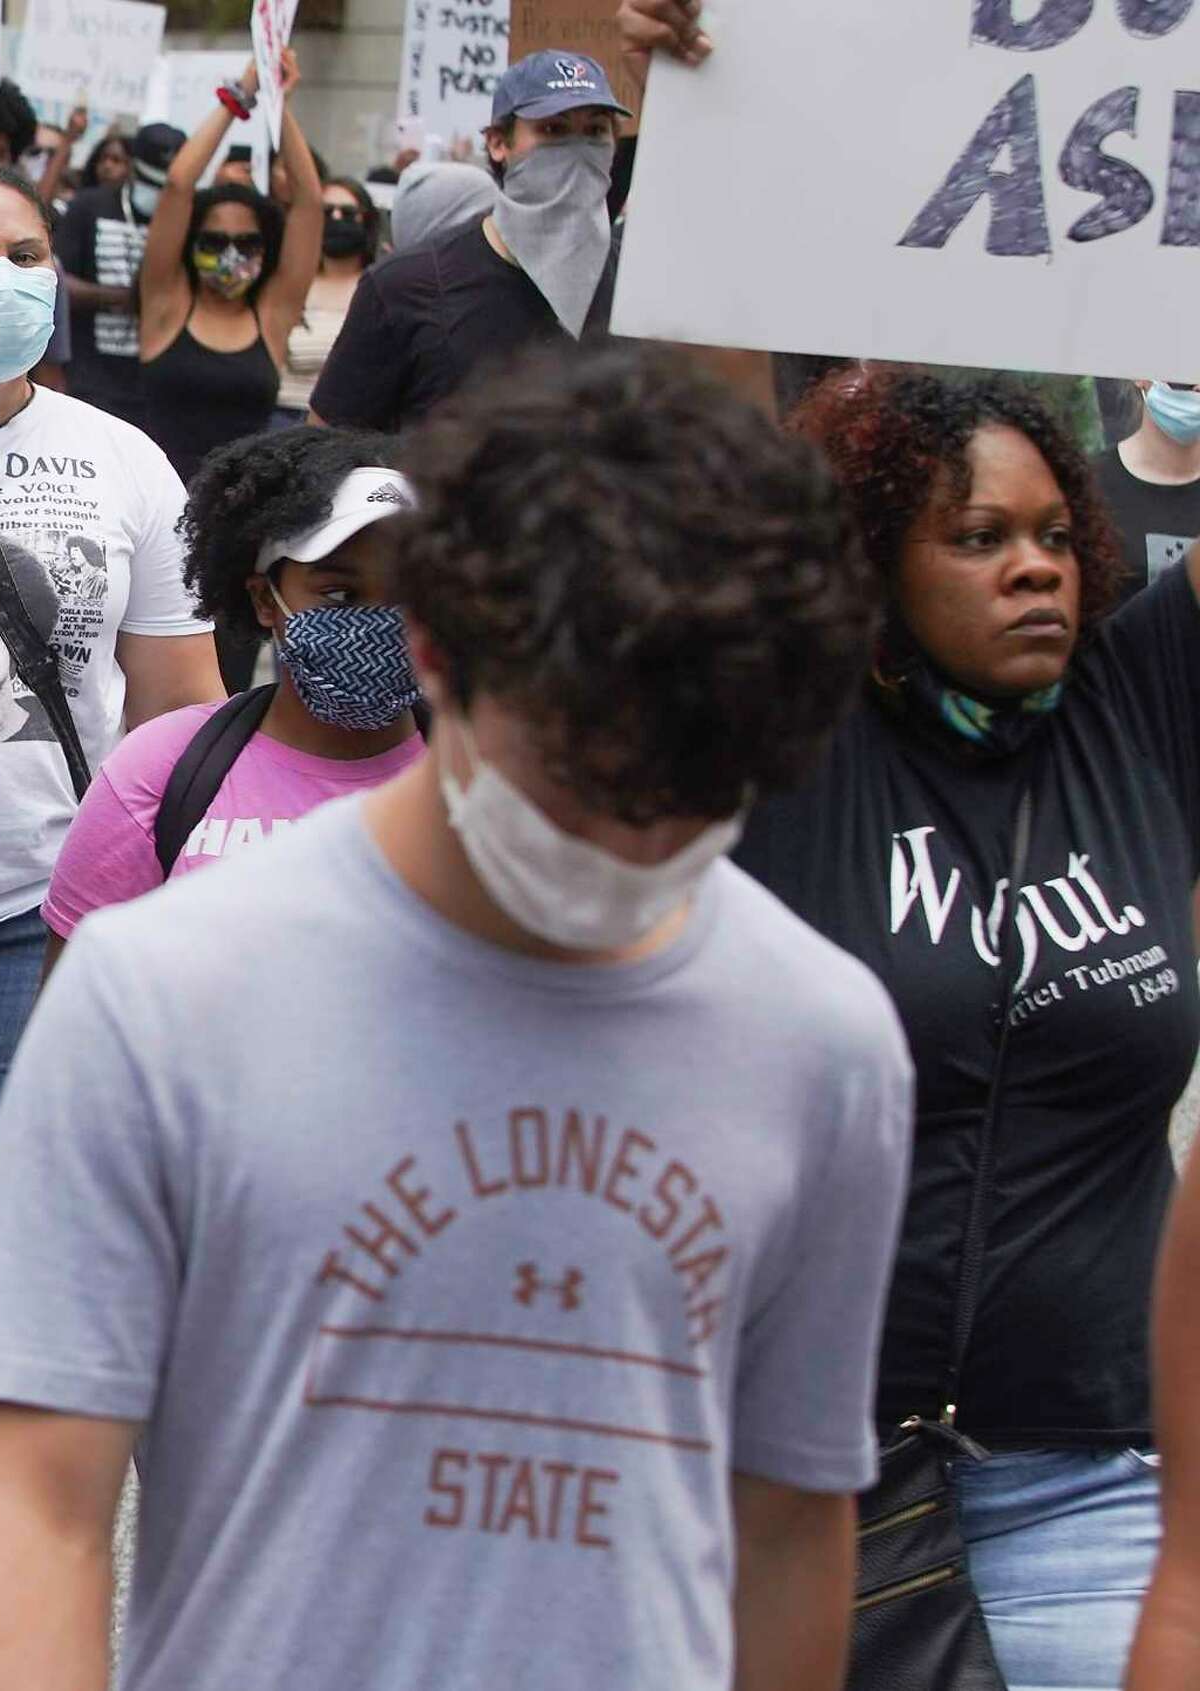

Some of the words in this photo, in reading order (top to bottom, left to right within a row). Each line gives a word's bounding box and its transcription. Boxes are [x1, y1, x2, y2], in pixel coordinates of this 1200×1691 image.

[438, 8, 509, 36] JUSTIC
[460, 44, 496, 66] NO
[5, 452, 97, 479] DAVIS
[19, 481, 79, 495] VOICE
[24, 507, 39, 516] of
[43, 507, 101, 521] struggle
[1064, 945, 1169, 991] Tubman
[1127, 967, 1180, 1008] 1849
[318, 1154, 459, 1304] THE
[454, 1105, 732, 1348] LONESTAR
[423, 1447, 620, 1550] STATE
